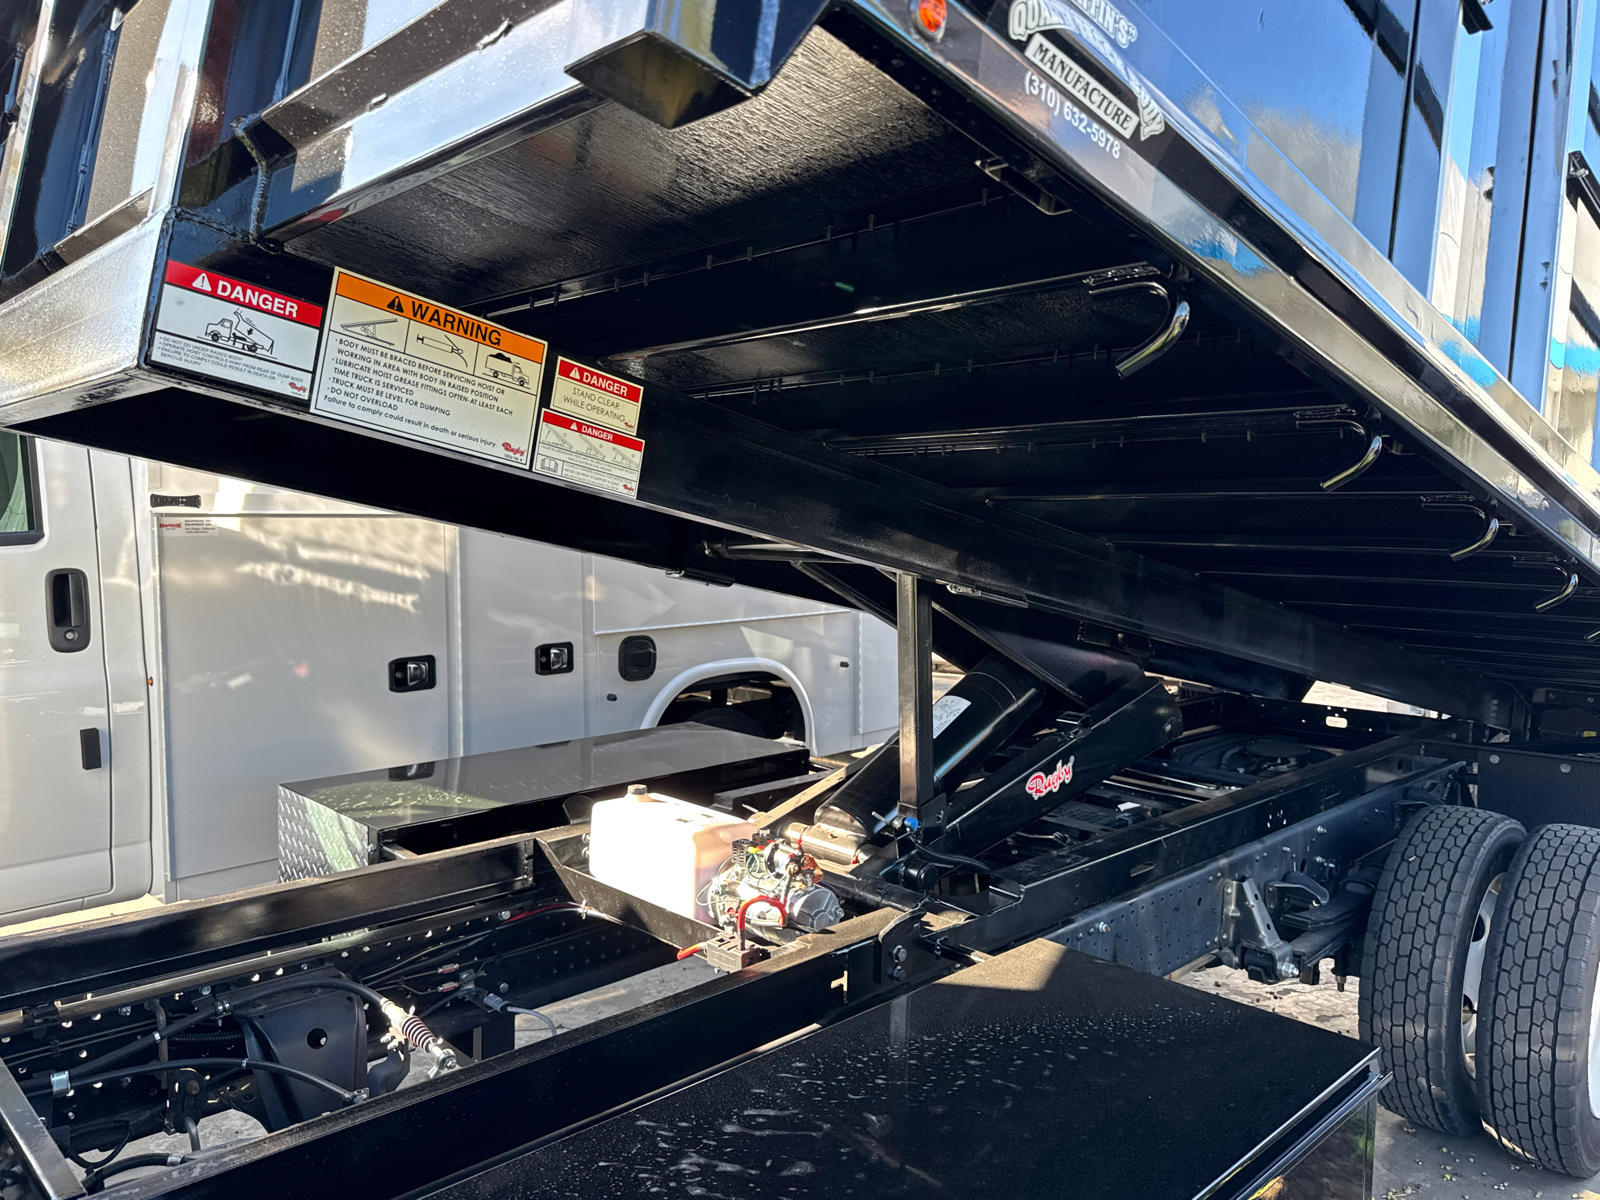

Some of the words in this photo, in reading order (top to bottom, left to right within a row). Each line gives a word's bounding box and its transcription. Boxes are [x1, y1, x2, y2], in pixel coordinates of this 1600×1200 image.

[1033, 42, 1133, 131] MANUFACTURE
[1025, 71, 1060, 116] (310)
[1063, 102, 1121, 159] 632-5978
[217, 280, 298, 317] DANGER
[412, 301, 501, 346] WARNING
[162, 347, 182, 356] FAILURE
[191, 354, 211, 364] COMPLY
[211, 359, 228, 368] COULD
[229, 365, 247, 373] RESULT
[163, 342, 185, 352] OPERATE
[202, 353, 228, 362] CONTROLS
[339, 338, 359, 350] BODY
[360, 345, 379, 356] MUST
[380, 351, 388, 359] BE
[389, 354, 417, 368] BRACED
[418, 362, 442, 375] BEFORE
[443, 370, 476, 386] SERVICING
[478, 382, 496, 392] HOIST
[334, 367, 350, 377] TIME
[351, 372, 373, 385] TRUCK
[374, 379, 381, 387] IS
[382, 381, 414, 396] SERVICED
[335, 357, 371, 374] LUBRICATE
[373, 368, 392, 379] HOIST
[393, 375, 419, 388] GREASE
[420, 383, 447, 396] FITTINGS
[478, 401, 495, 411] LEAST
[496, 407, 513, 416] EACH
[337, 348, 372, 364] WORKING
[373, 358, 381, 367] IN
[382, 362, 400, 373] AREA
[402, 368, 418, 378] WITH
[420, 373, 440, 384] BODY
[448, 381, 469, 394] RAISED
[471, 389, 499, 402] POSITION
[583, 371, 628, 397] DANGER
[330, 387, 342, 396] DO
[344, 391, 359, 400] NOT
[360, 396, 398, 411] OVERLOAD
[332, 377, 355, 389] TRUCK
[356, 383, 375, 394] MUST
[376, 389, 384, 398] BE
[385, 392, 404, 404] LEVEL
[405, 398, 418, 407] FOR
[420, 402, 451, 416] DUMPING
[563, 395, 585, 410] WHILE
[586, 403, 626, 423] OPERATING
[572, 387, 596, 402] STAND
[597, 396, 620, 410] CLEAR
[324, 395, 347, 406] Failure
[357, 403, 383, 417] comply
[384, 412, 404, 422] could
[405, 417, 423, 427] result
[430, 424, 449, 435] death
[458, 433, 480, 443] serious
[480, 438, 498, 448] injury.
[581, 425, 613, 442] DANGER
[502, 442, 525, 456] Rugby
[1026, 757, 1075, 800] Rugby
